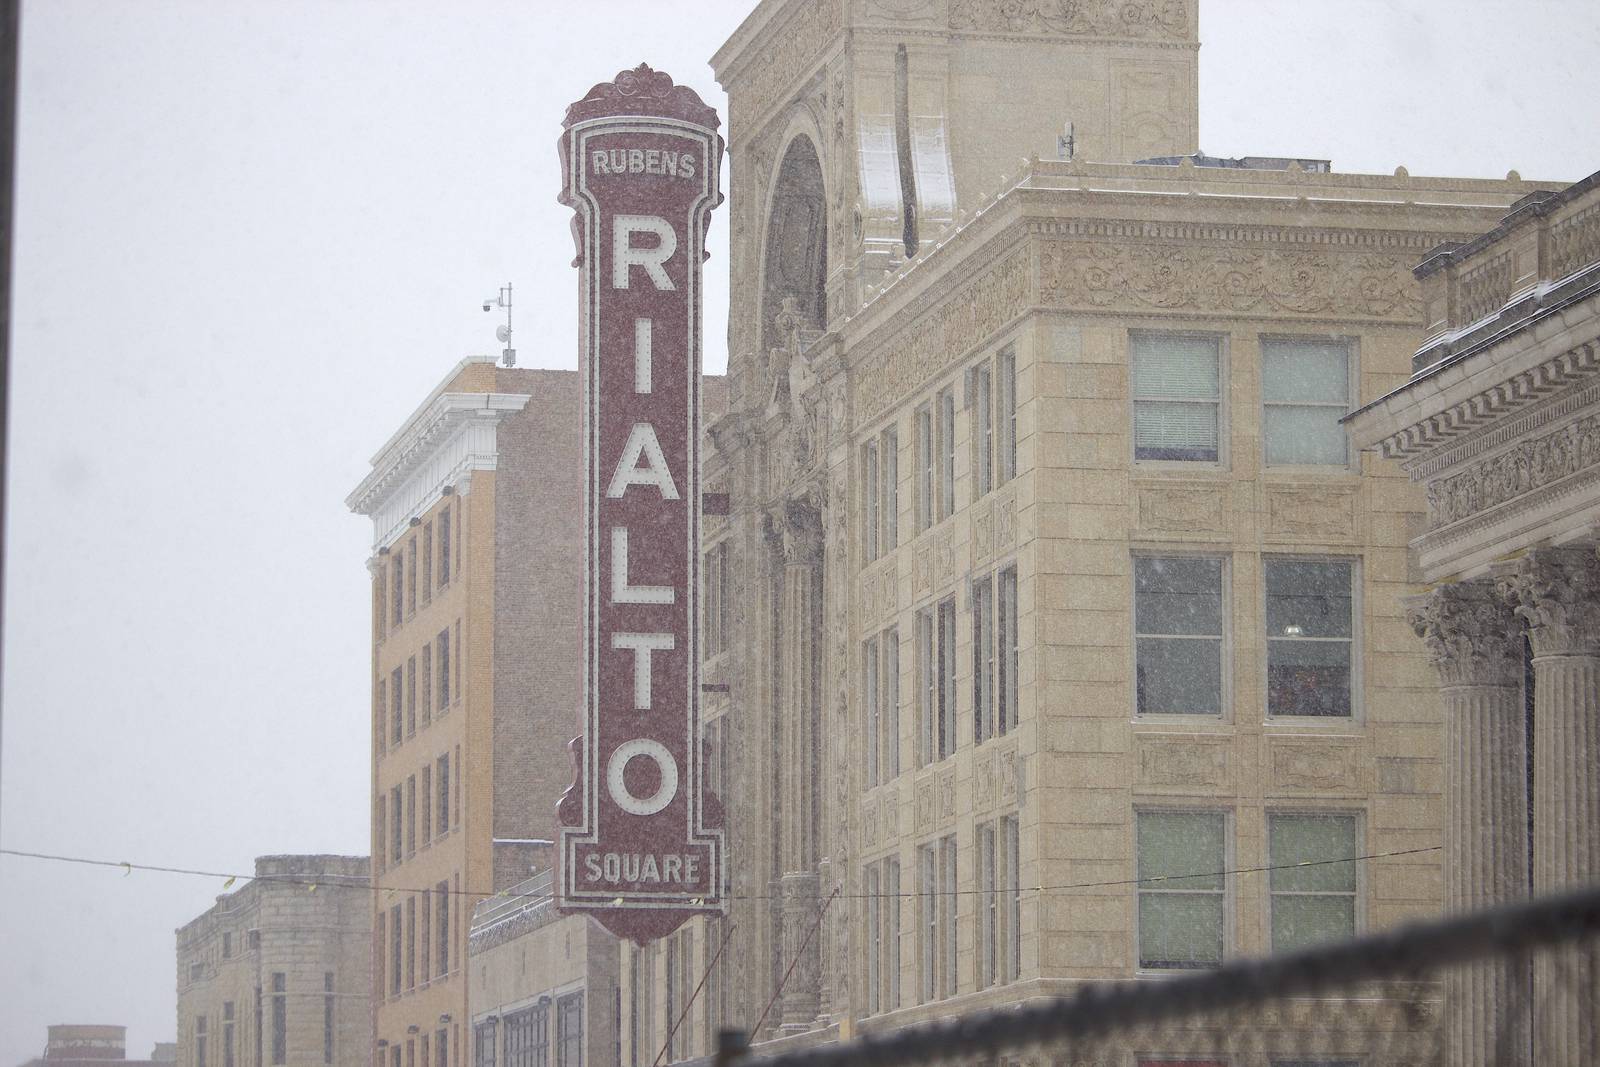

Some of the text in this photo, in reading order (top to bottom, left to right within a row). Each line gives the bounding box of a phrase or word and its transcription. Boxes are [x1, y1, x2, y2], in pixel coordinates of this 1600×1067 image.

[592, 150, 696, 179] RUBENS
[606, 214, 680, 816] RIALTO
[584, 853, 701, 885] SQUARE
